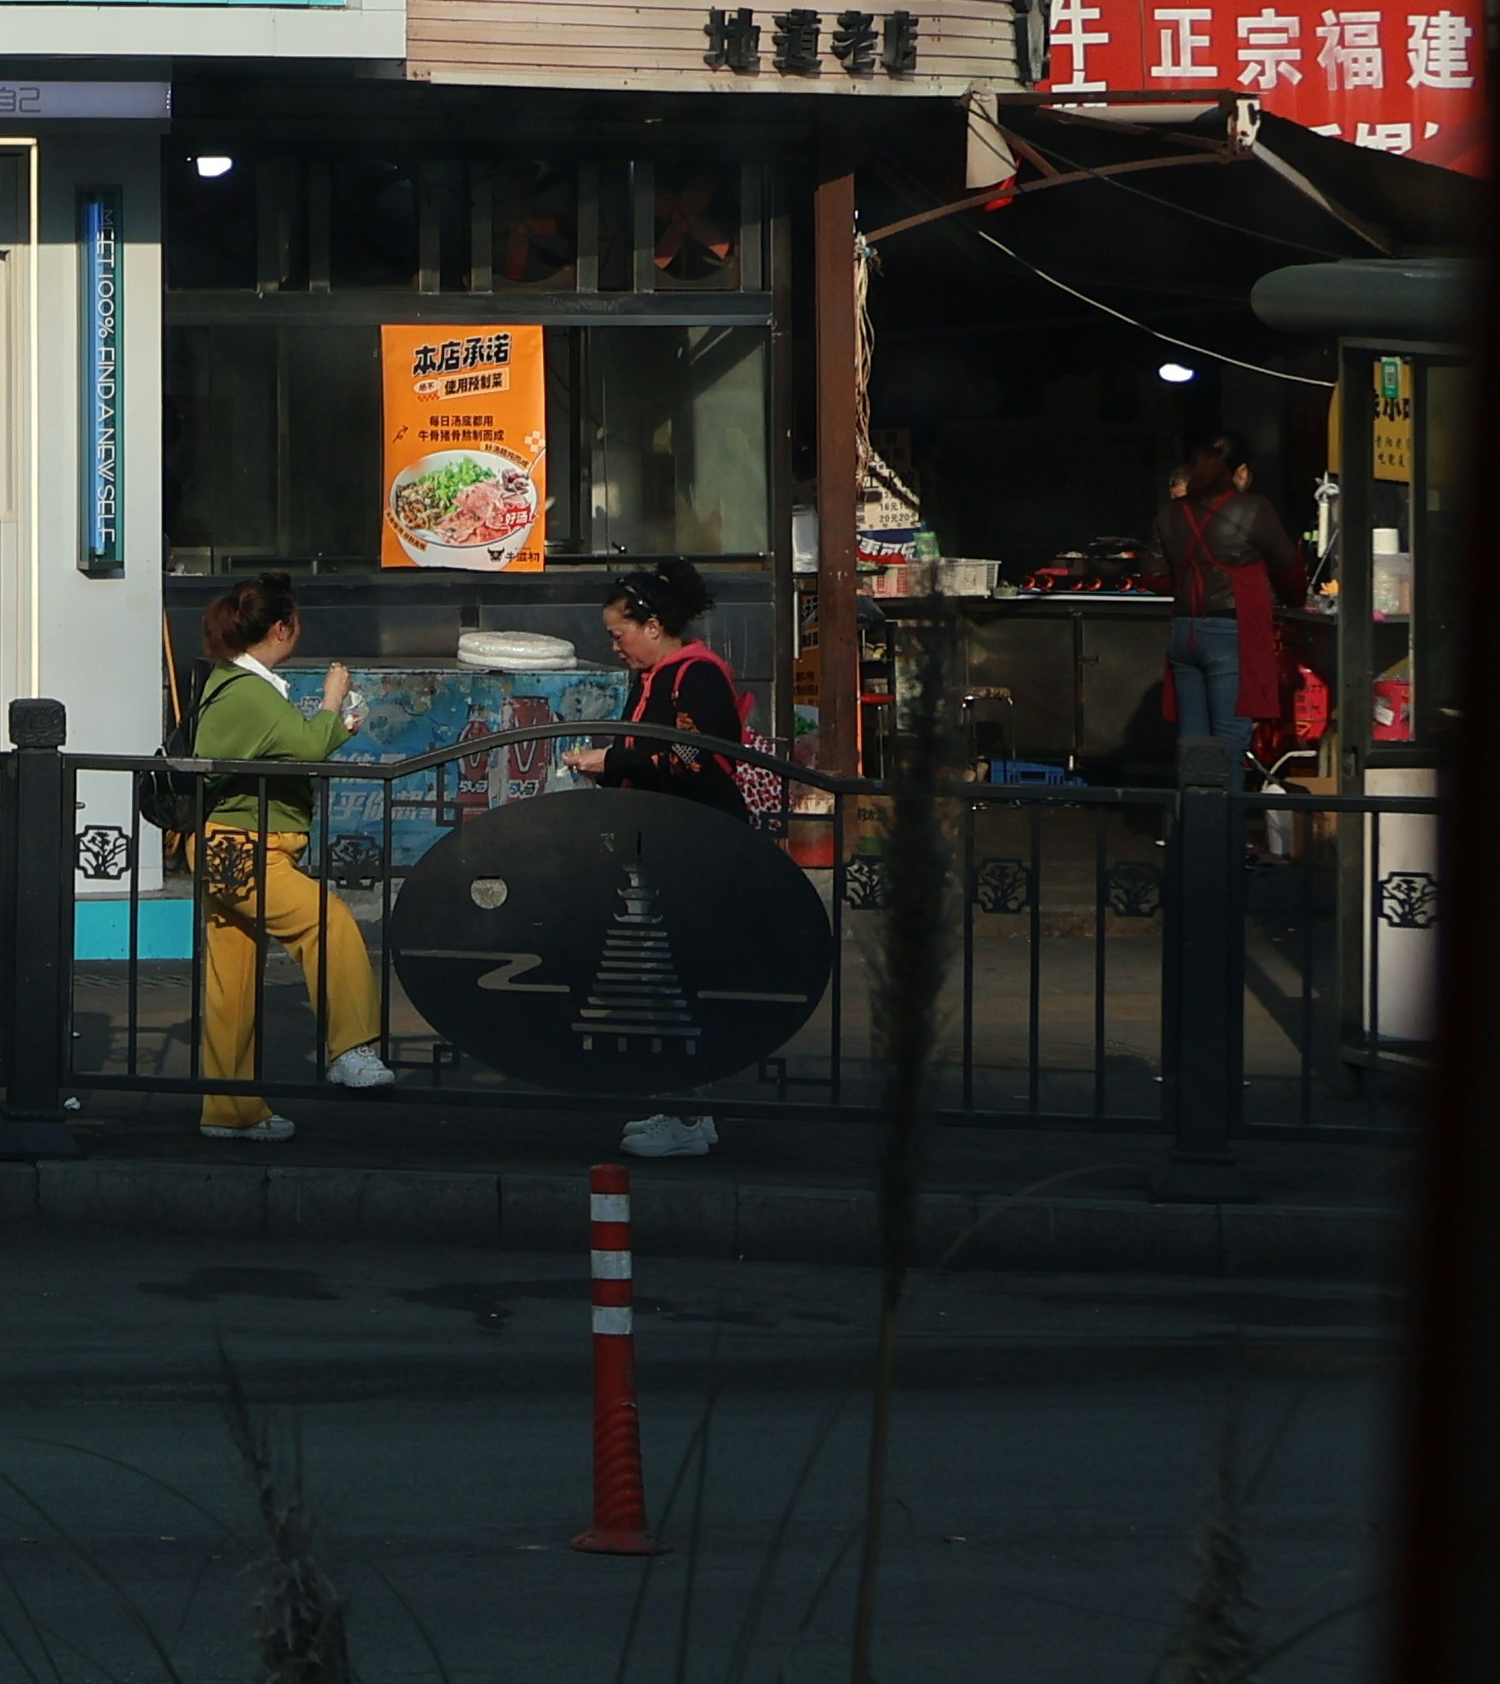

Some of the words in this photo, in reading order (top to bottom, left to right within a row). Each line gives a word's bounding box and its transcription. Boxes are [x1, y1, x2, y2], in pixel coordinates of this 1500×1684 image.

[1150, 7, 1476, 92] 正宗福建
[97, 346, 115, 401] FIND
[412, 333, 511, 376] 本店承诺
[443, 372, 503, 396] 使用预制菜
[97, 404, 115, 423] A
[429, 415, 494, 427] 每日汤底都用
[97, 427, 115, 482] NEW
[97, 485, 116, 543] SELF
